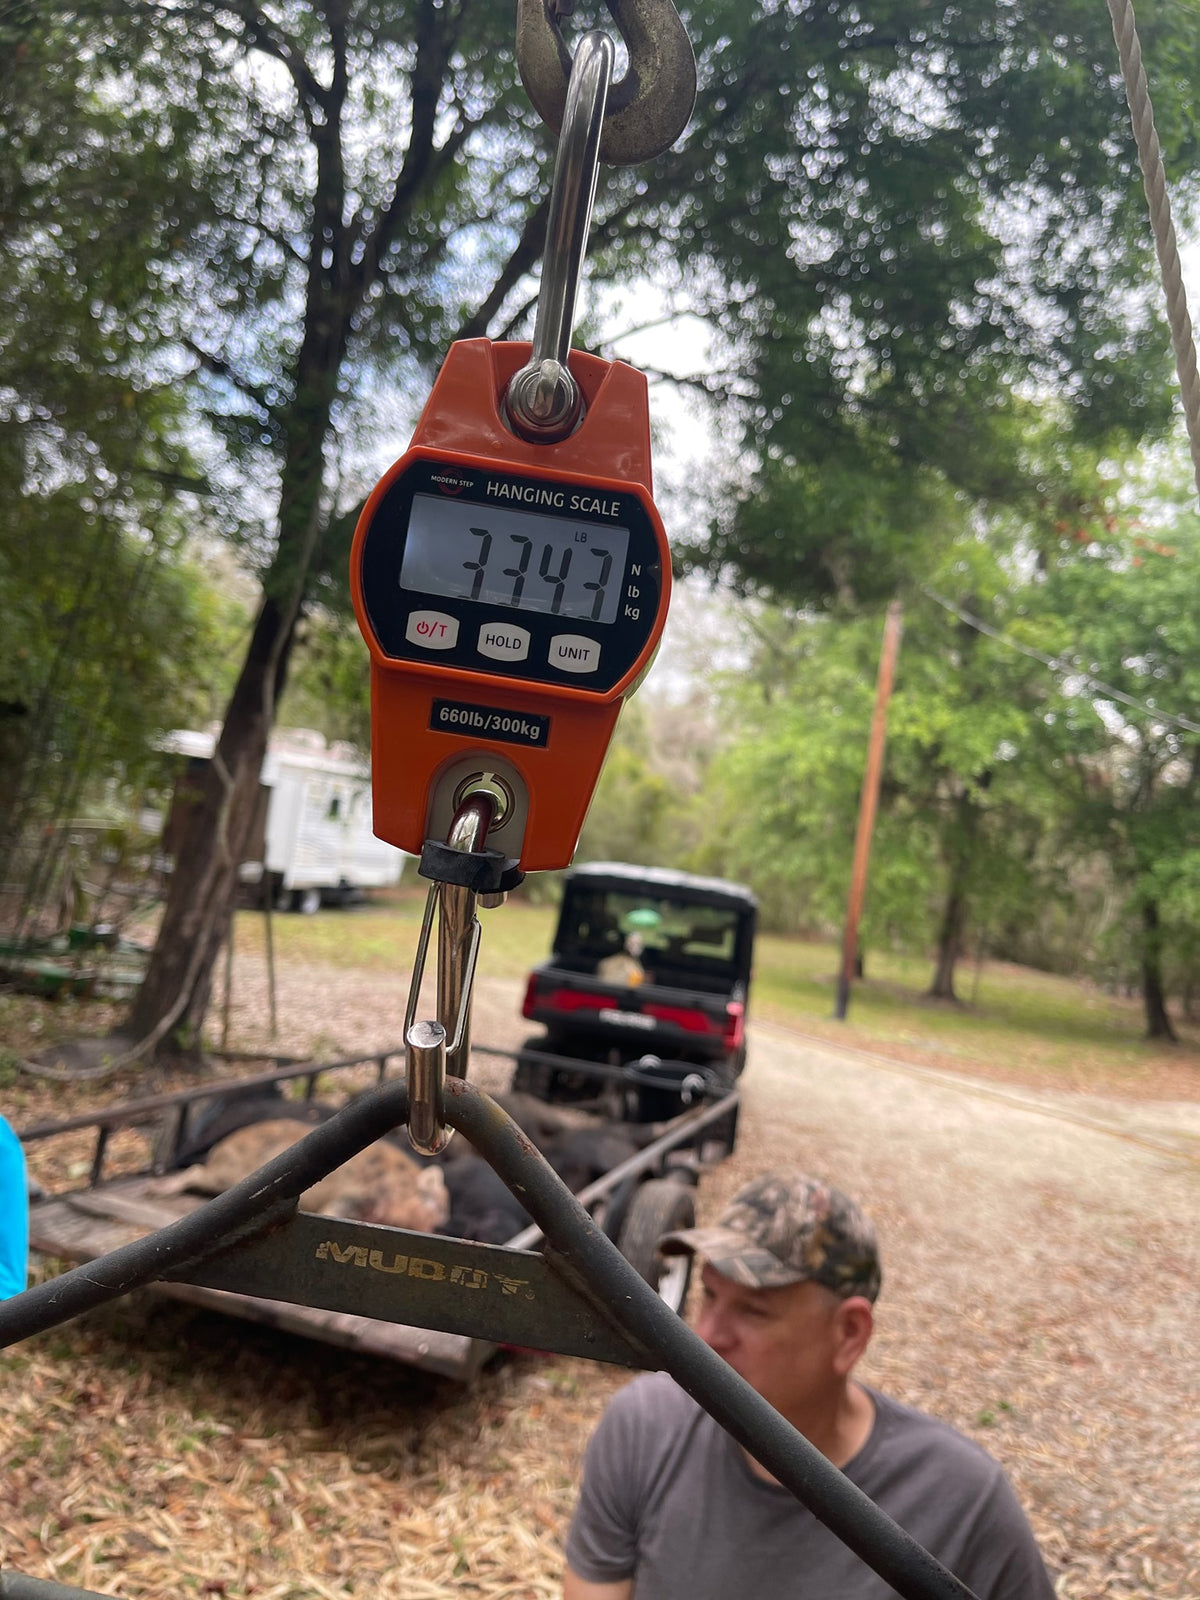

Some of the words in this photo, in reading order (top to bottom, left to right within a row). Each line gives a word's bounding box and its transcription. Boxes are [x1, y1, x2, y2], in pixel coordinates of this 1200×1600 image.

[431, 475, 458, 485] MODERN
[459, 480, 474, 488] STEP
[486, 481, 564, 507] HANGING
[569, 496, 621, 517] SCALE
[574, 531, 588, 543] LB
[631, 564, 641, 576] N
[628, 585, 640, 598] lb
[624, 605, 640, 620] kg
[485, 634, 522, 650] HOLD
[558, 646, 590, 661] UNIT
[439, 707, 541, 740] 660lb/300kg
